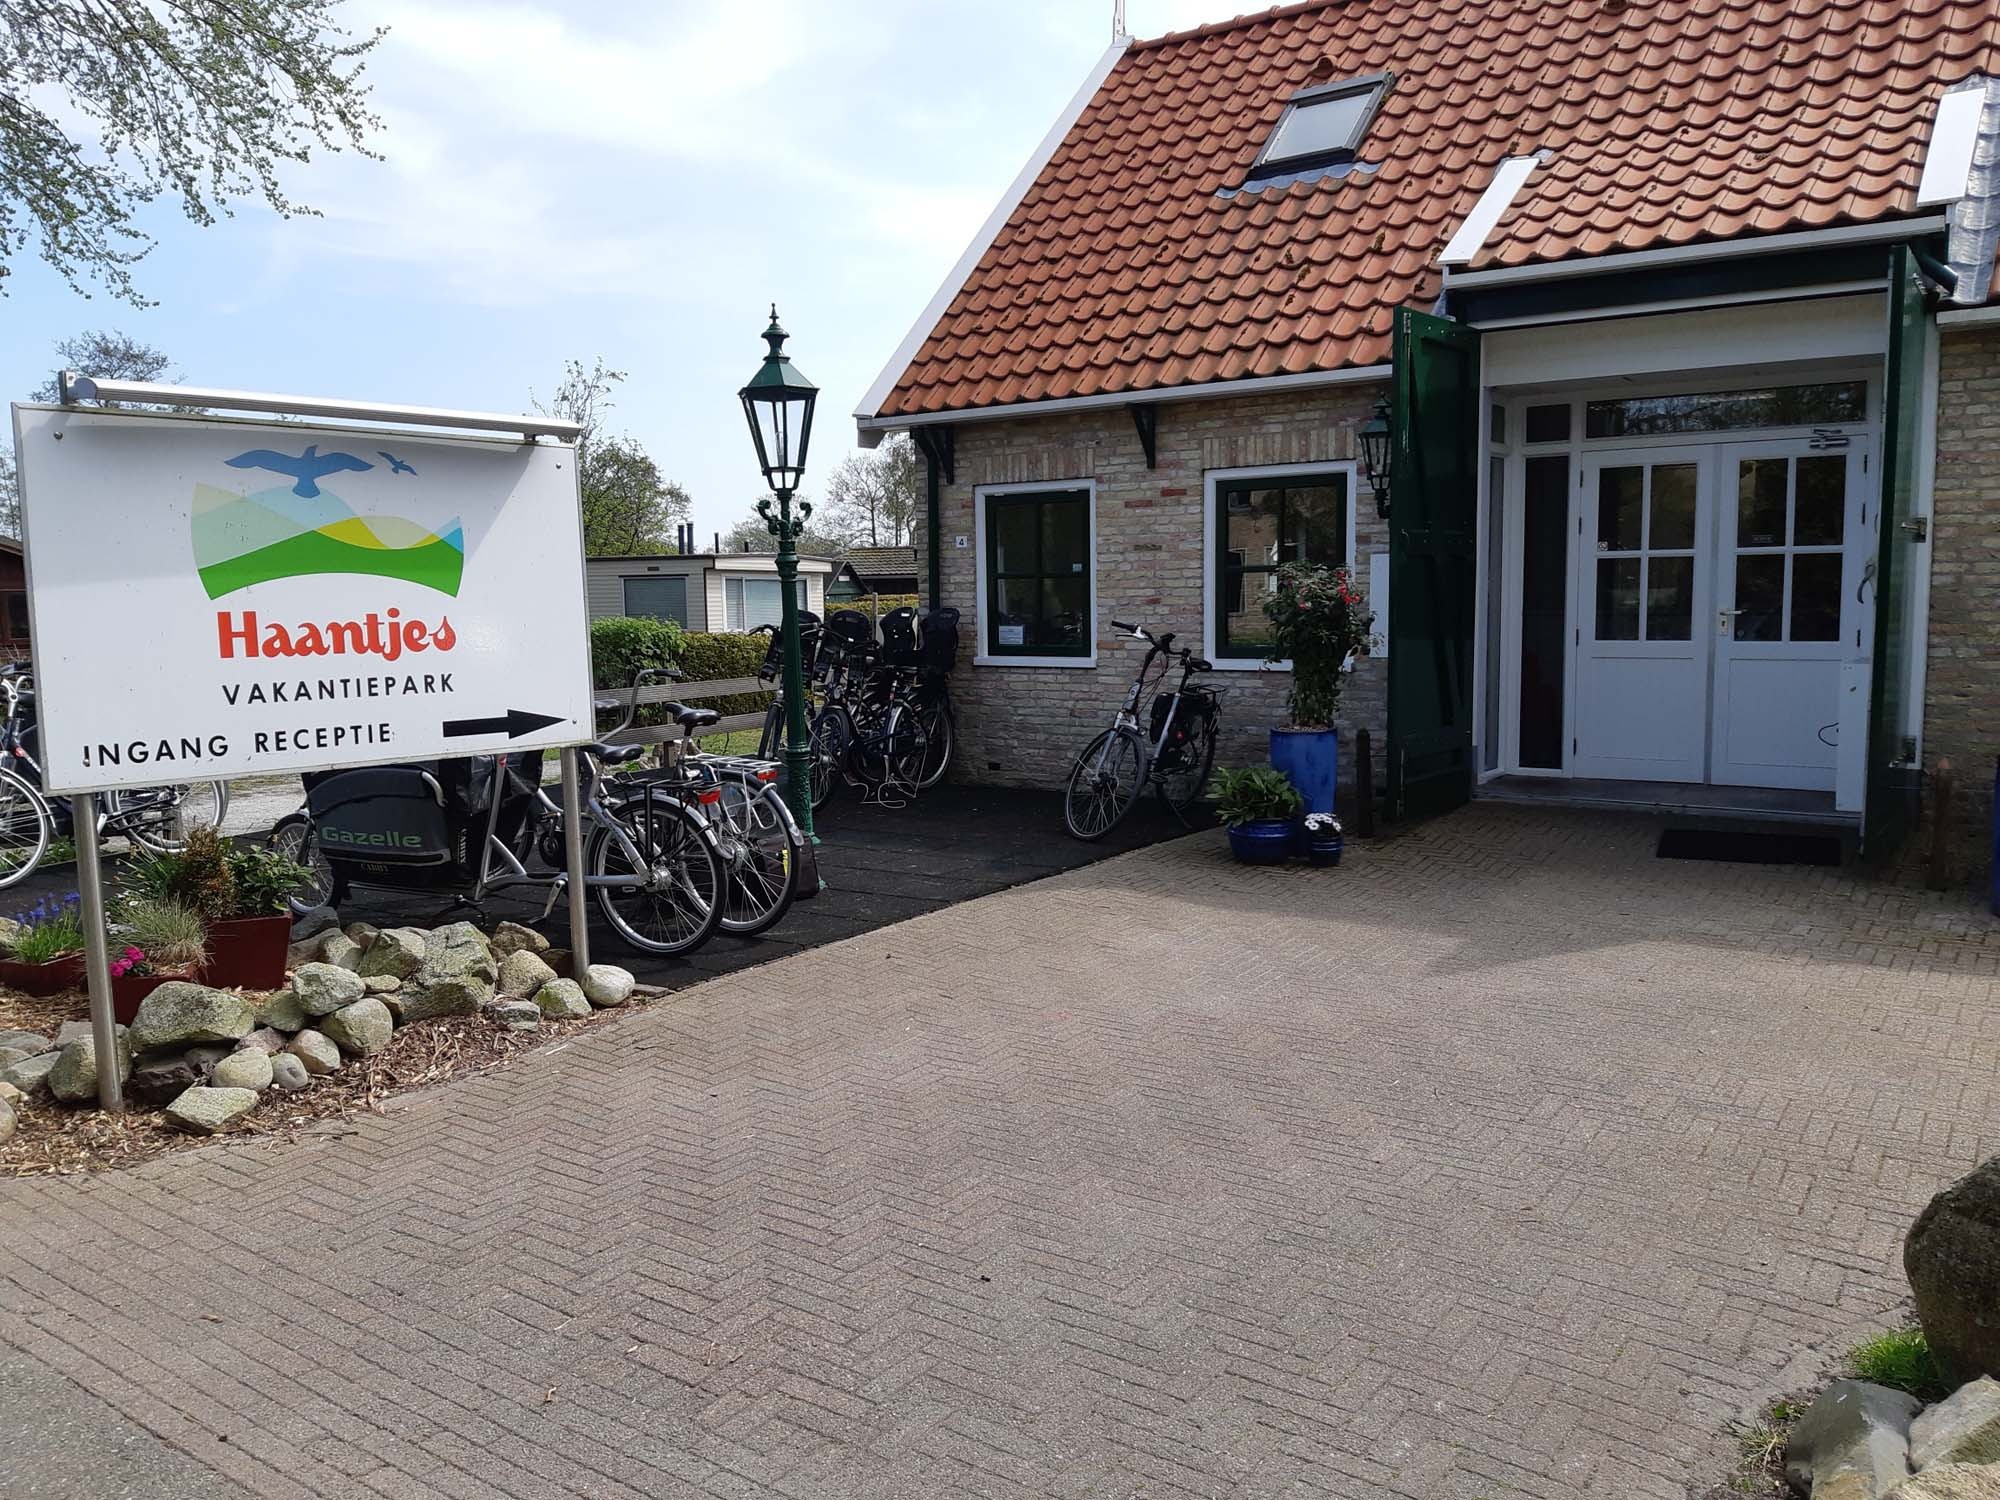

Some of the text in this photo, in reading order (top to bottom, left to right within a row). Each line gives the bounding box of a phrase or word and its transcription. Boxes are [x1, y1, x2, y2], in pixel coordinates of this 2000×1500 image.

[217, 607, 457, 661] Haantjes
[222, 673, 454, 705] VAKANTIEPARK
[82, 723, 391, 767] INGANG RECEPTIE
[321, 826, 422, 848] Gazelle
